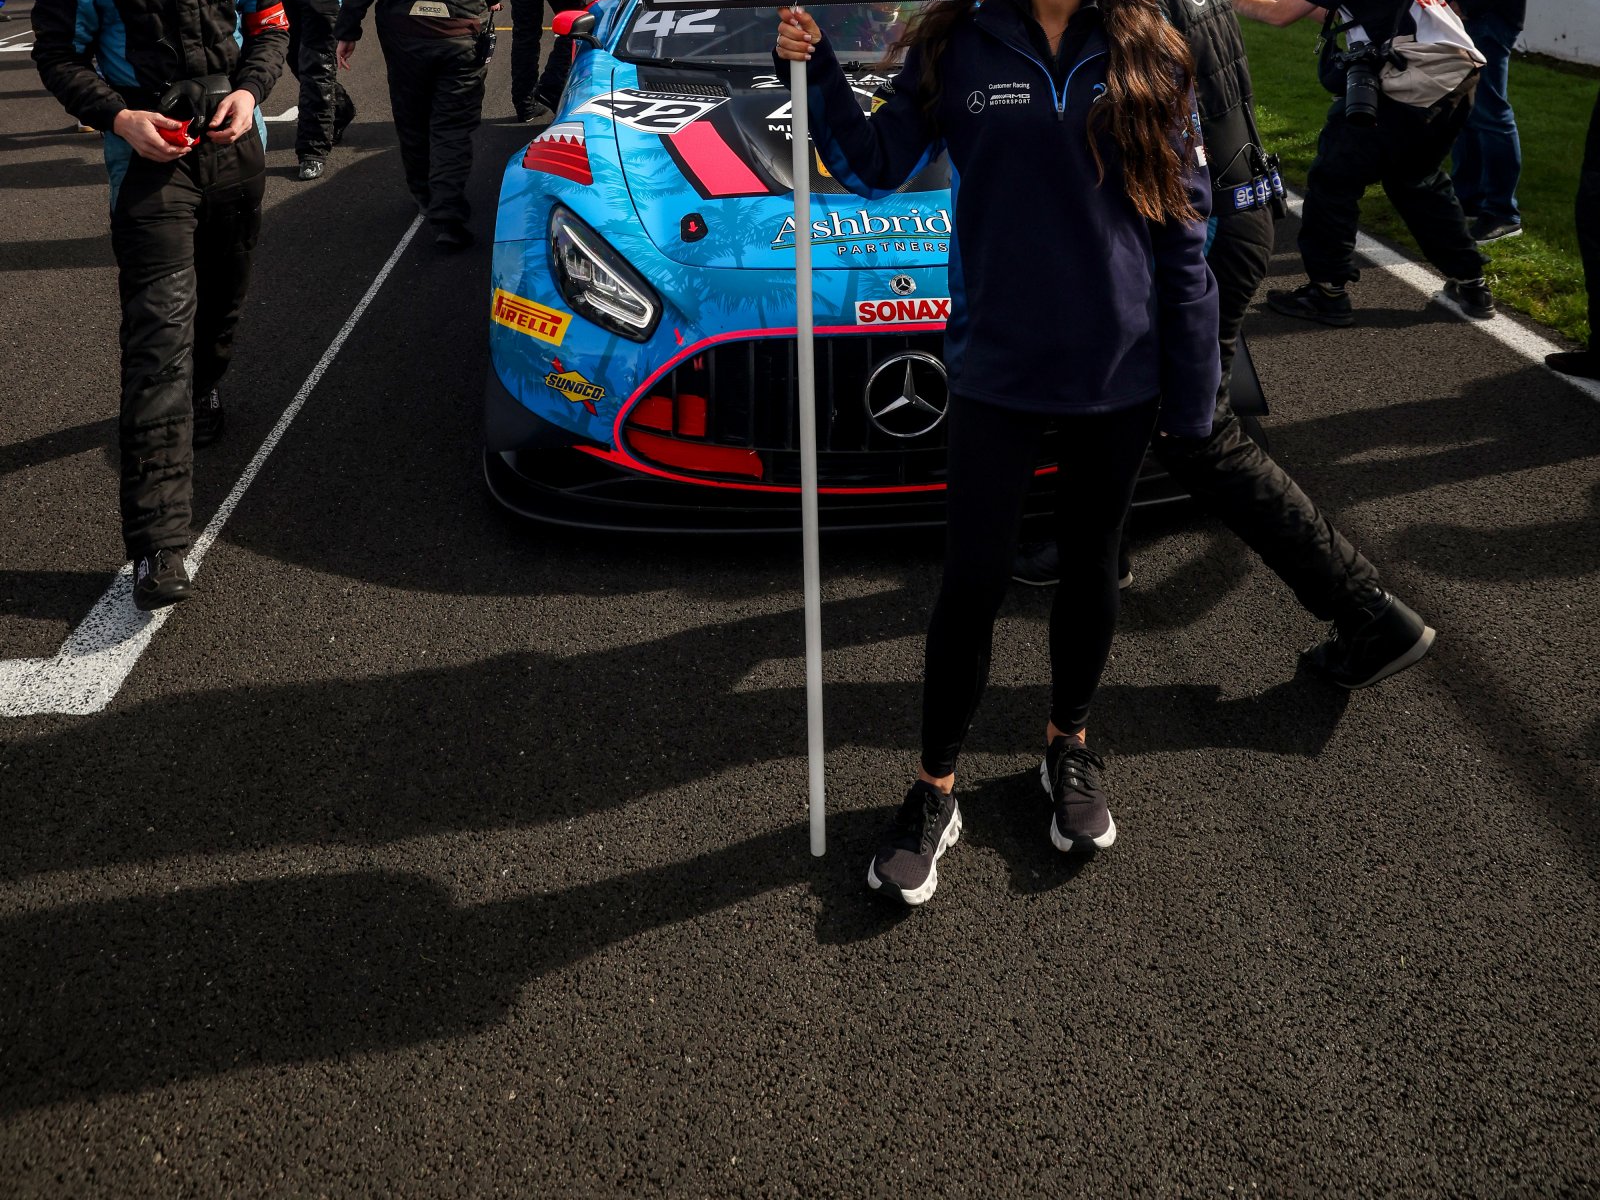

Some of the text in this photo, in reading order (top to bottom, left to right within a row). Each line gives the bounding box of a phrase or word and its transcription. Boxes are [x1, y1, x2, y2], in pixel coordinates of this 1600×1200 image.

[632, 9, 721, 38] 42
[591, 99, 702, 128] 42
[772, 209, 951, 243] Ashbrid
[837, 242, 948, 255] PARTNERS
[495, 295, 562, 337] PIRELLI
[859, 300, 950, 322] SONAX
[547, 375, 602, 399] SUNOCO
